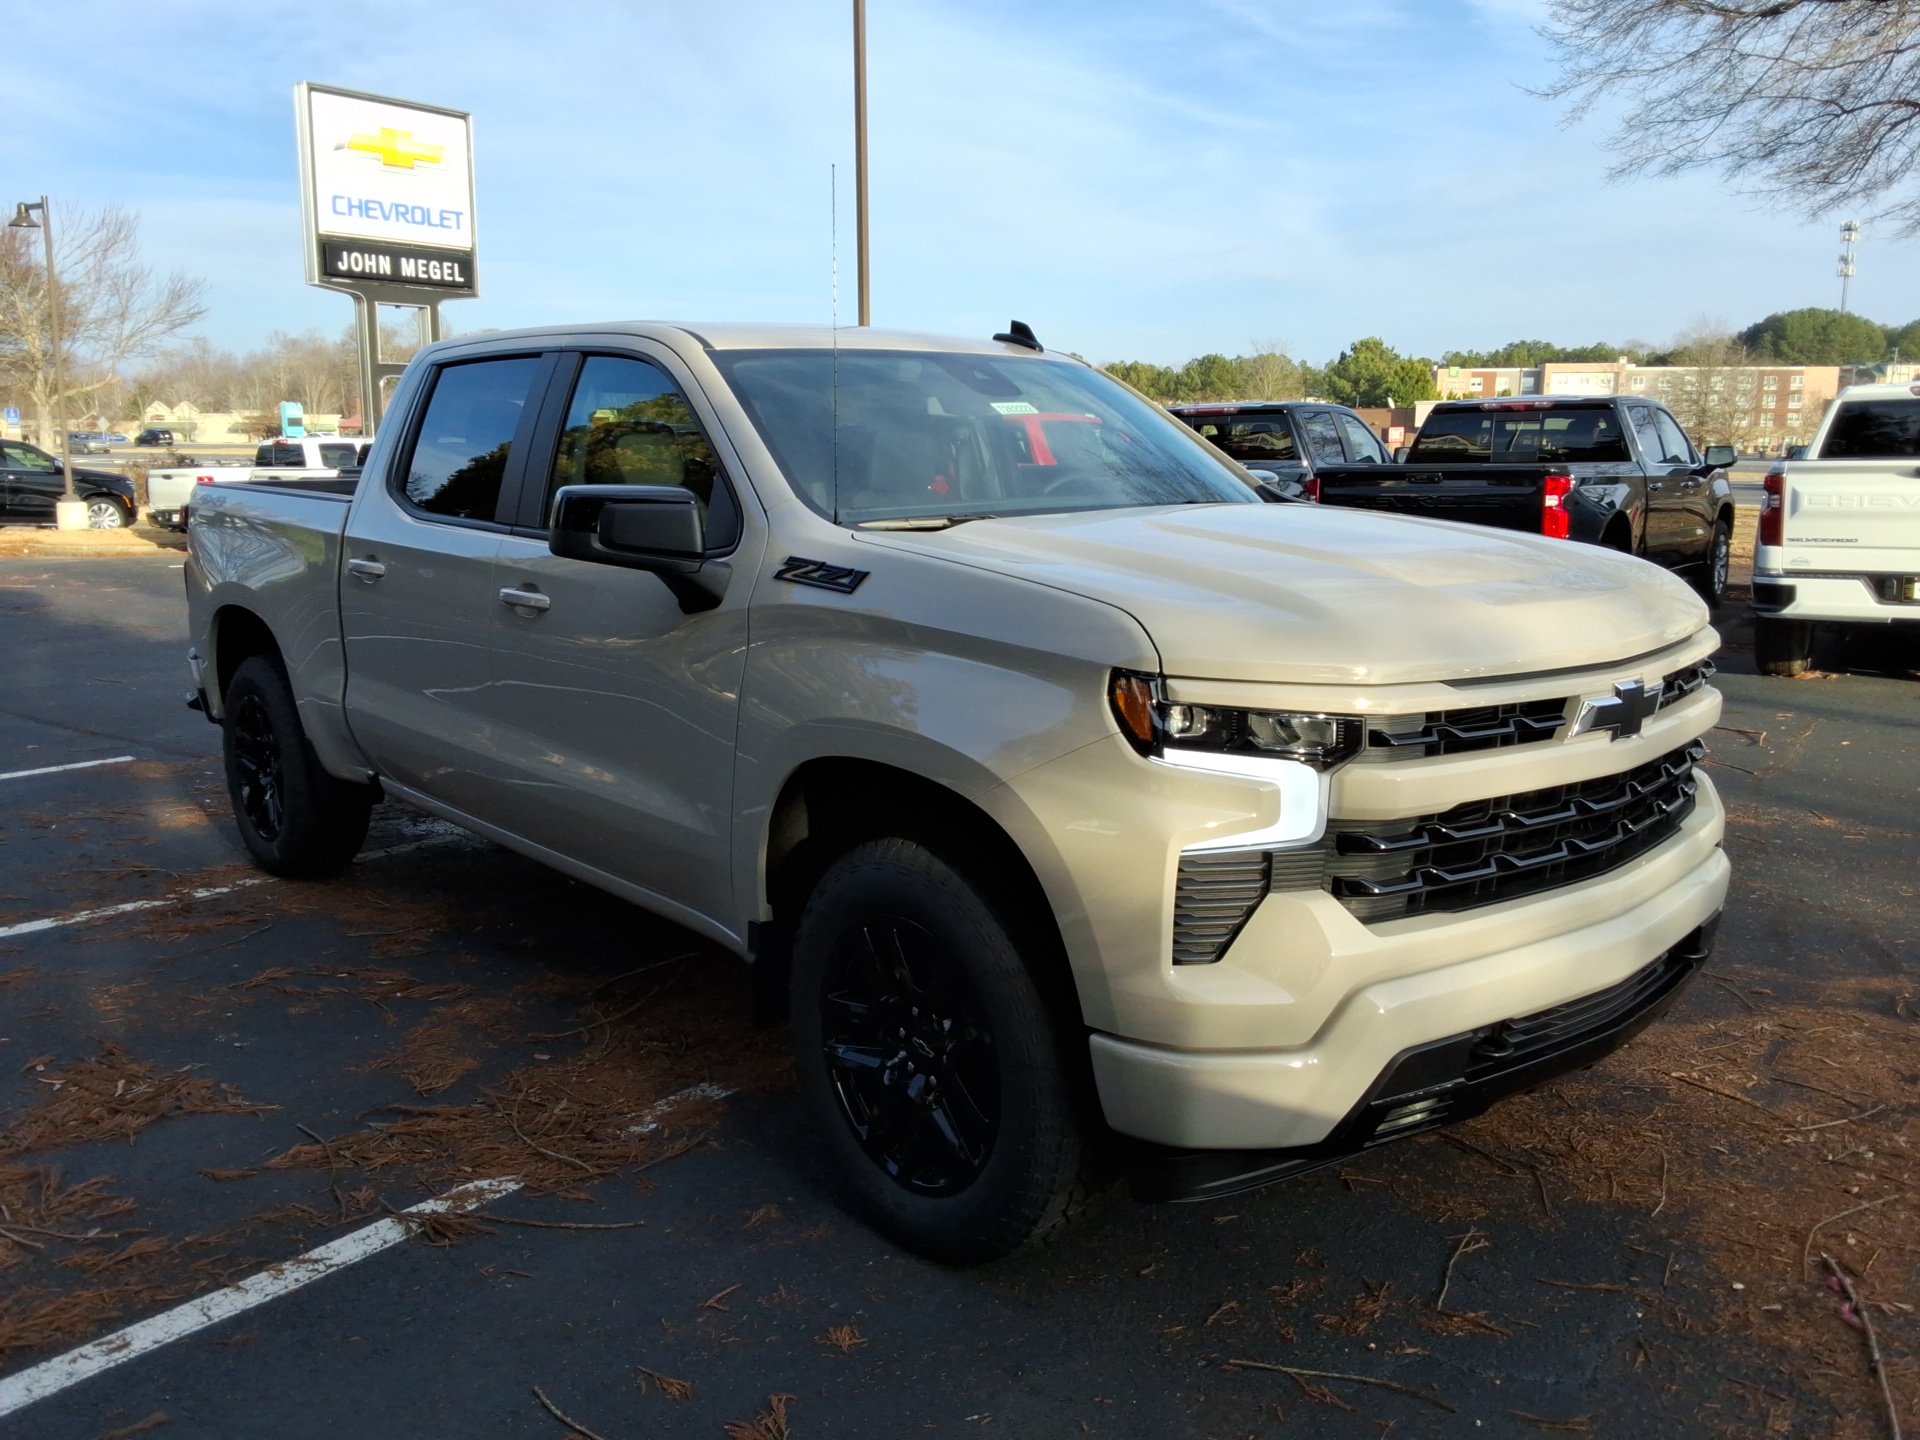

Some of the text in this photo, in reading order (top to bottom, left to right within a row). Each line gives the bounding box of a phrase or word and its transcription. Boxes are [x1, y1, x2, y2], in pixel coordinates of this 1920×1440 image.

[332, 195, 464, 230] CHEVROLET
[338, 251, 465, 282] JOHN MEGEL
[772, 555, 871, 595] Z71
